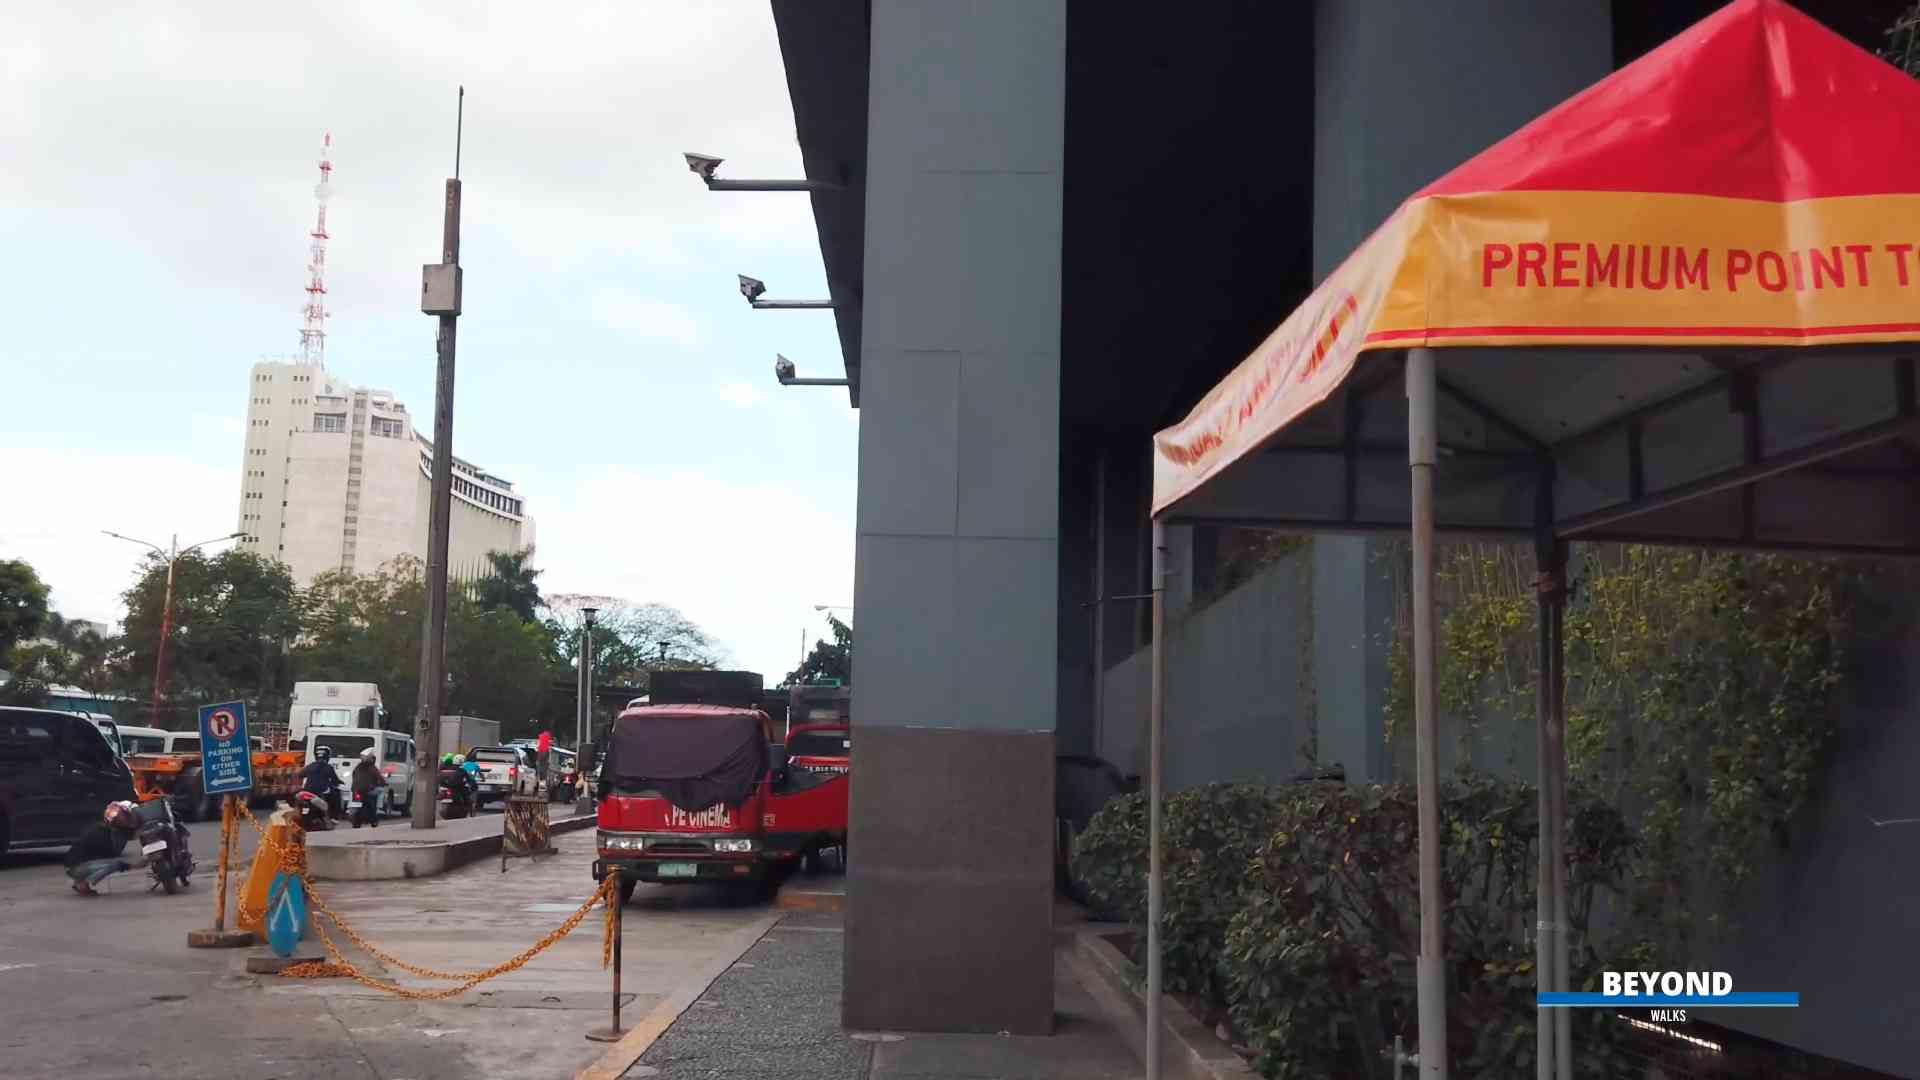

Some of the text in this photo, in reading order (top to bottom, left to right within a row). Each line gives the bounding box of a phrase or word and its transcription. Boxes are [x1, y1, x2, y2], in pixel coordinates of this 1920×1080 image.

[1481, 242, 1920, 292] PREMIUM POINT T
[208, 746, 243, 757] PARKING
[212, 760, 241, 770] EITHER
[218, 767, 237, 776] SIDE
[664, 802, 731, 829] PE CINEMA
